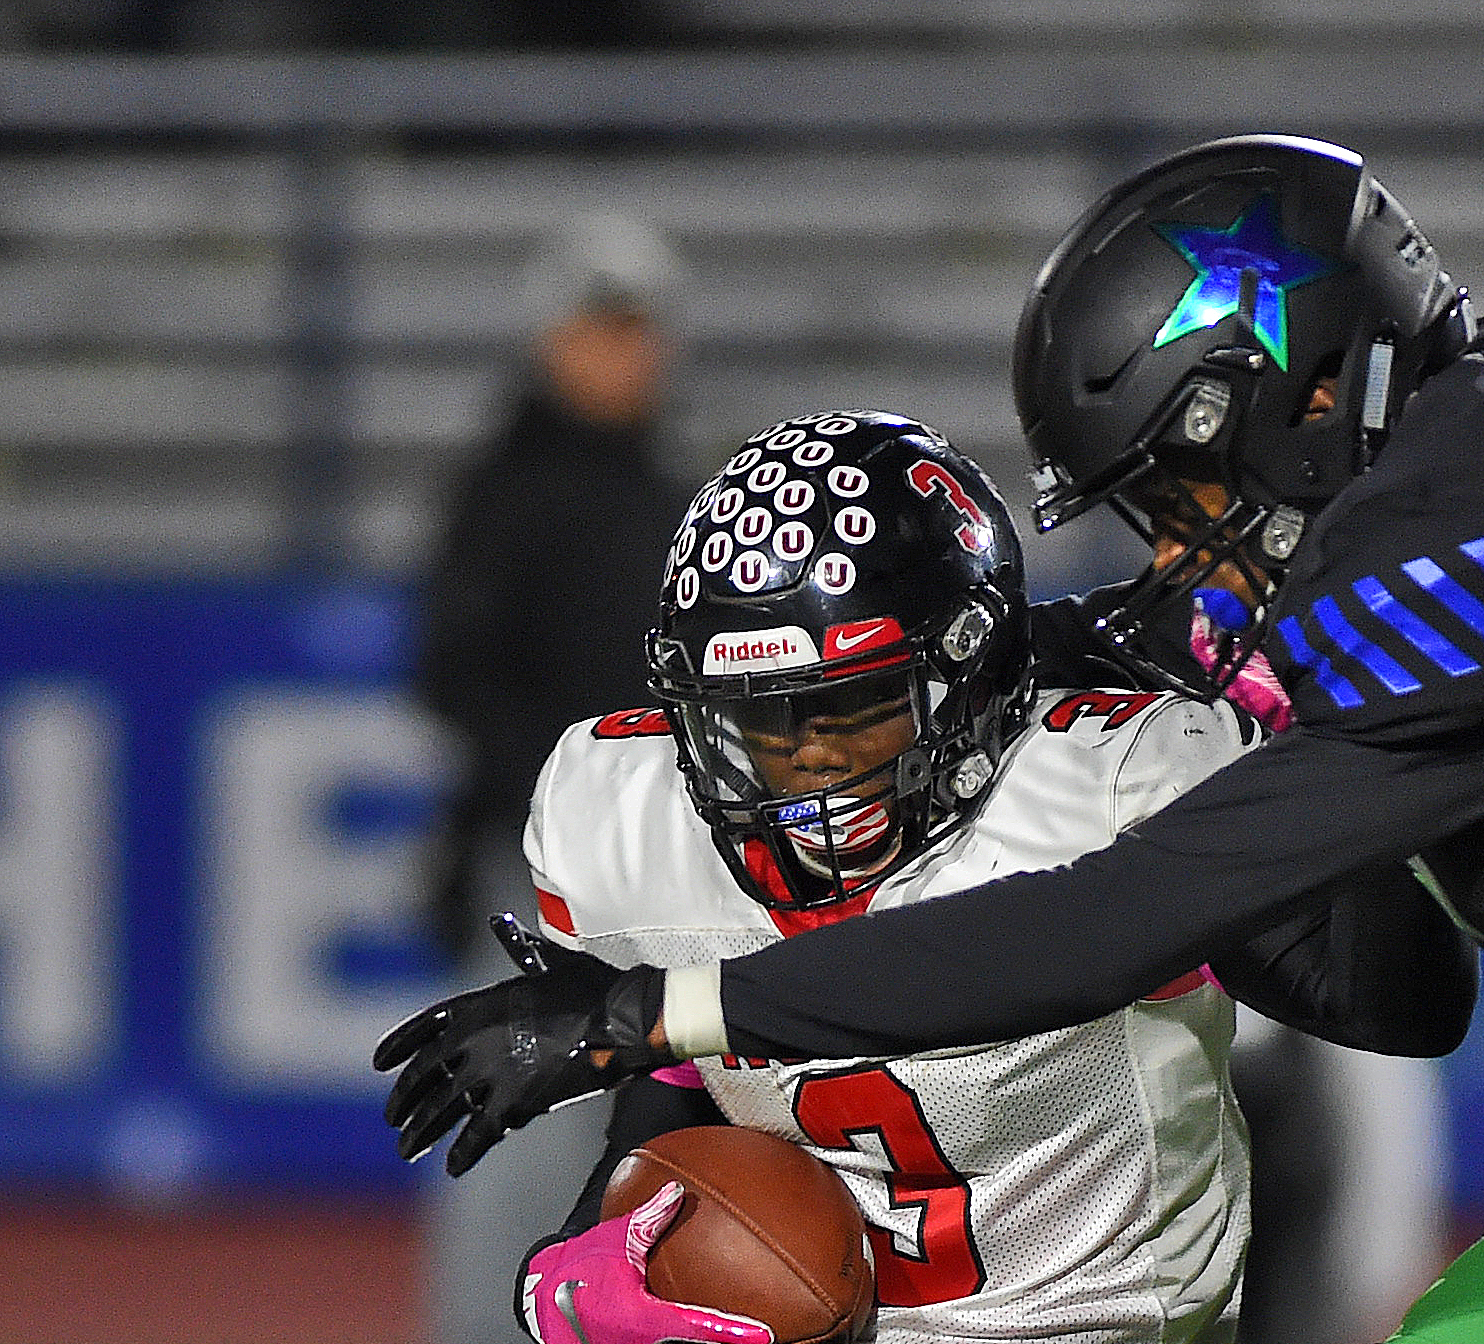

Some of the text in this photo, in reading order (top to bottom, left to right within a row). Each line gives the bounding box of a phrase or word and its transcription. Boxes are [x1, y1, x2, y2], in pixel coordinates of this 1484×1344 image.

[801, 446, 828, 461] U
[756, 467, 780, 486] U
[836, 471, 862, 492] U
[717, 493, 737, 517] U
[782, 488, 807, 508] U
[906, 459, 995, 555] 3
[742, 515, 765, 538] U
[844, 514, 868, 538] U
[707, 538, 726, 565] U
[781, 529, 805, 554] U
[740, 559, 761, 585] U
[823, 562, 848, 588] U
[681, 574, 695, 602] U
[791, 1061, 988, 1308] 3
